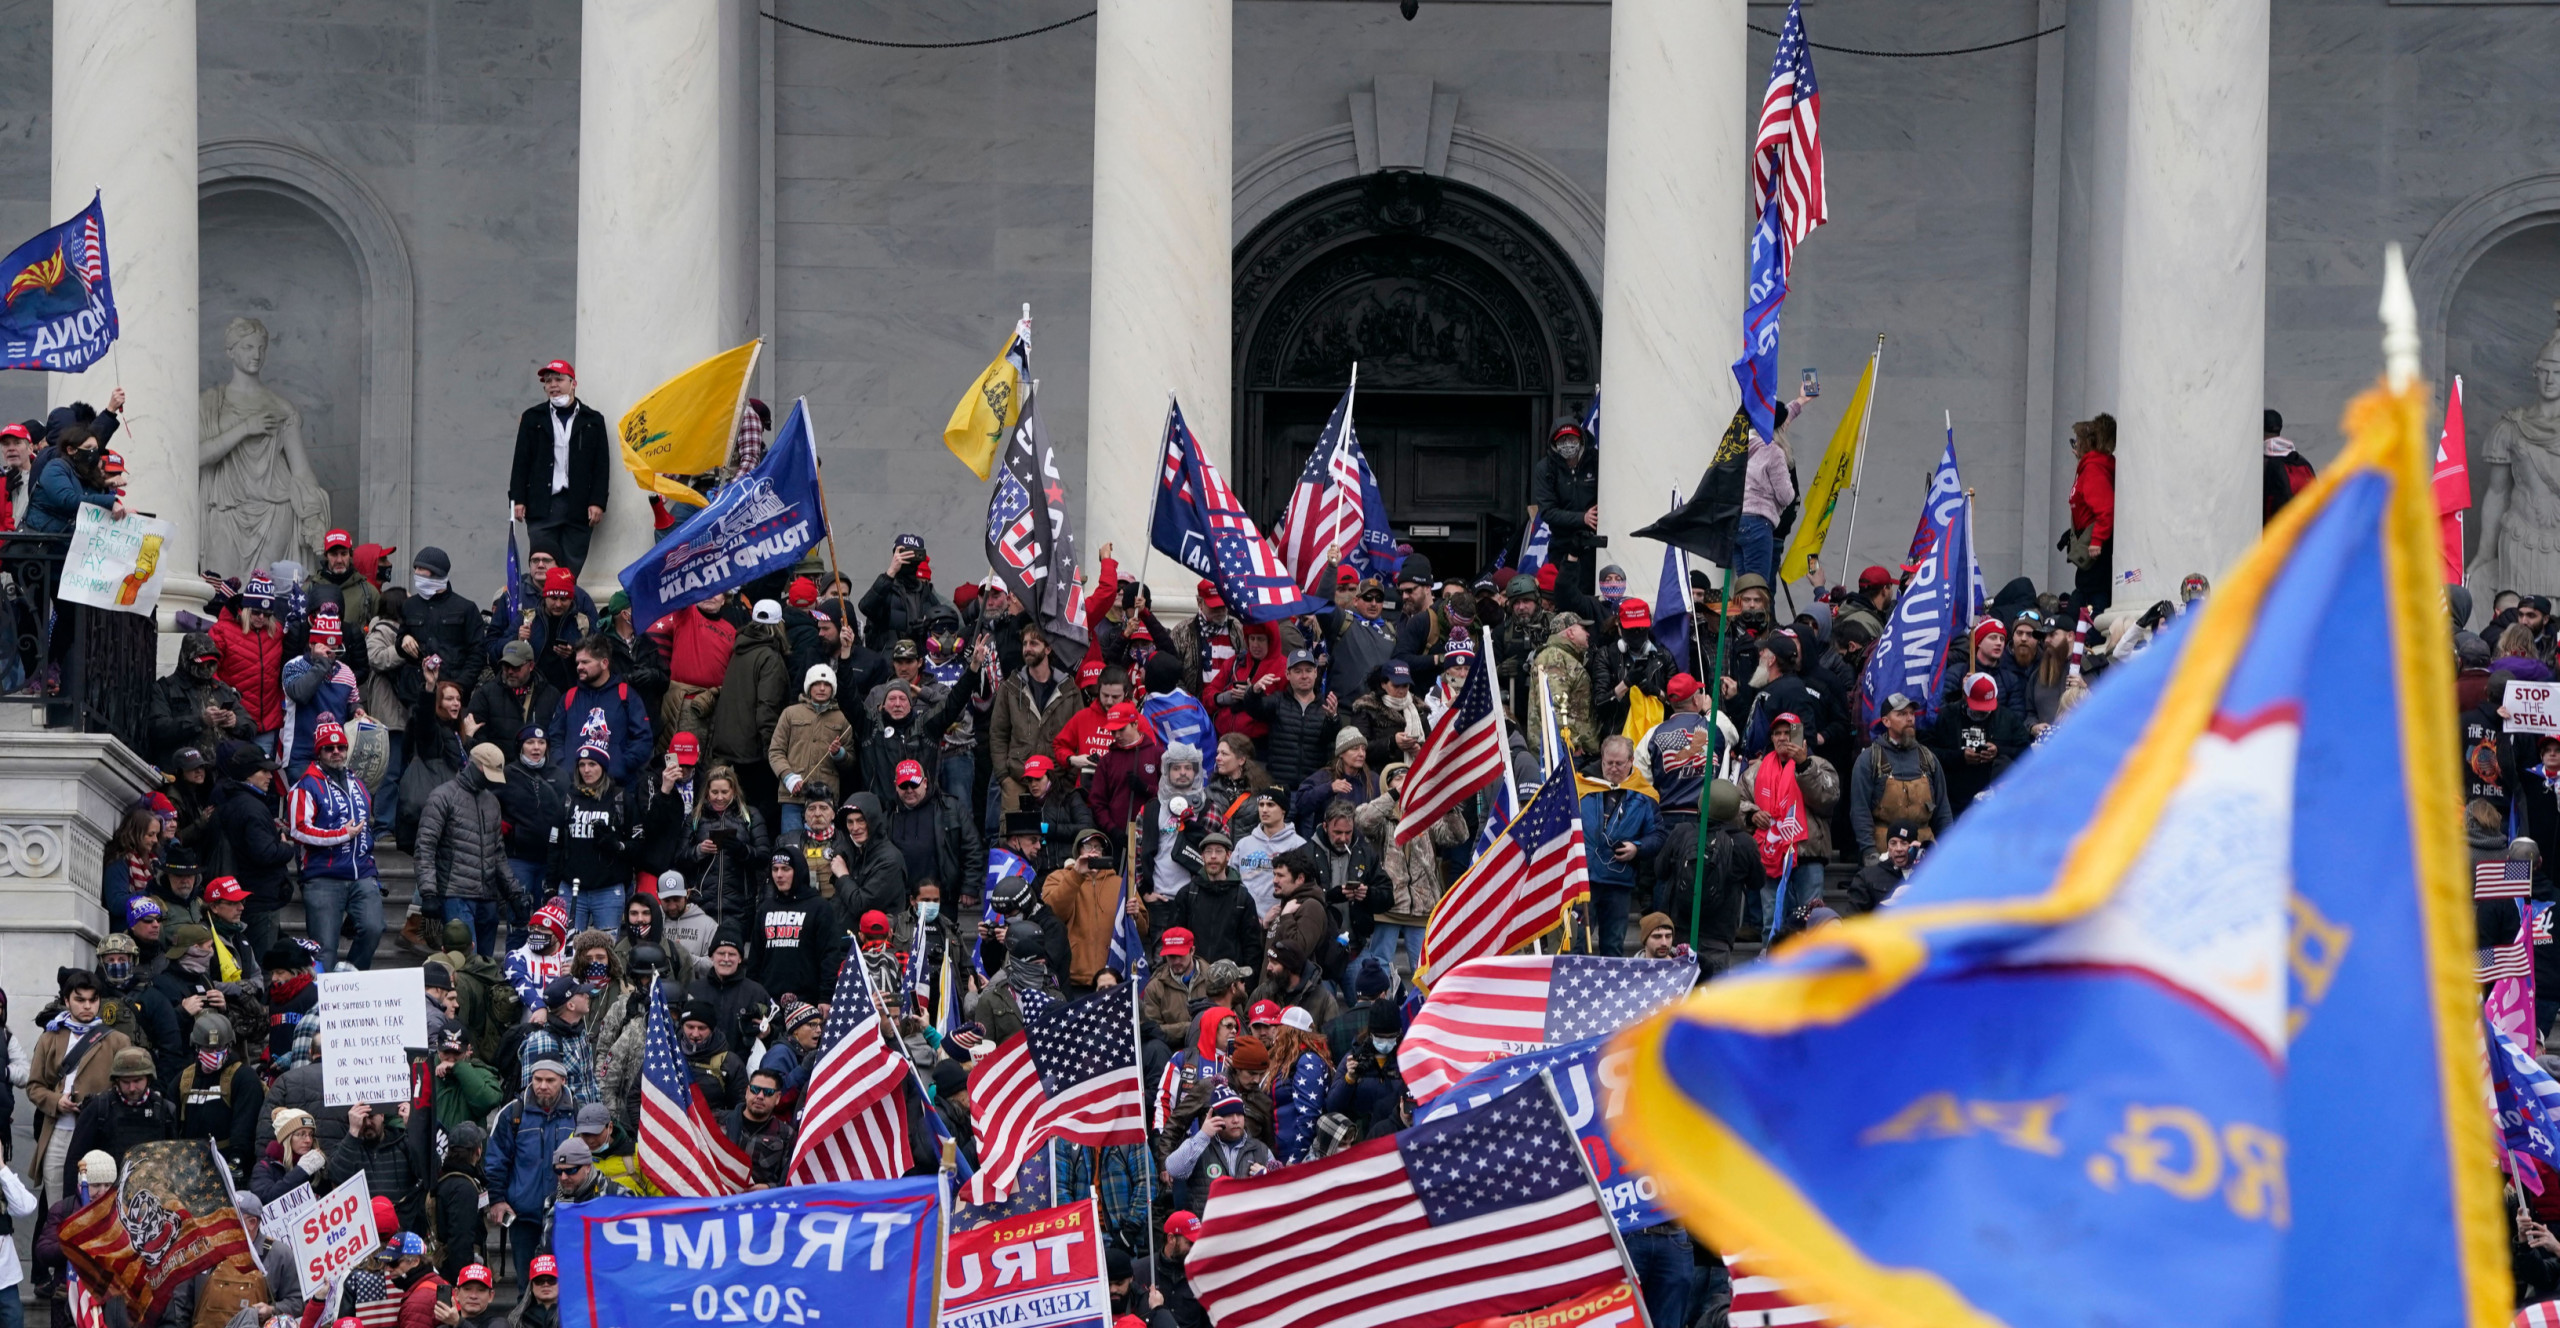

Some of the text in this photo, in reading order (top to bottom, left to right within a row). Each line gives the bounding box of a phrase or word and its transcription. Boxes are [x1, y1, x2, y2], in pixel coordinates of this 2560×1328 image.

[85, 507, 106, 523] YOU
[904, 536, 920, 547] USA
[1363, 529, 1388, 545] EEP
[2515, 688, 2550, 701] STOP
[2522, 701, 2544, 714] THE
[2513, 713, 2557, 728] STEAL
[1096, 727, 1113, 736] KE
[2468, 725, 2484, 739] THE
[1085, 736, 1117, 747] AMER
[1090, 747, 1110, 757] GRE
[2472, 783, 2480, 795] IS
[358, 808, 369, 858] AMRICA
[212, 889, 221, 898] 45
[765, 911, 806, 926] BIDEN
[664, 927, 698, 936] LACK RIFLE
[776, 926, 801, 938] NOT
[2533, 938, 2554, 947] EDOM
[320, 998, 403, 1012] ARE WE SUPPOSED TO HAVE
[326, 1015, 404, 1030] AN IRRATIONAL FEAR
[331, 1039, 340, 1049] OF
[343, 1038, 357, 1048] ALL
[337, 1058, 347, 1068] OR
[353, 1056, 374, 1066] ONLY
[380, 1055, 396, 1065] THE
[335, 1077, 349, 1086] FOR
[355, 1075, 380, 1085] WHICH
[325, 1087, 411, 1105] HAS A VACCINE TO SE
[280, 1185, 312, 1215] INJURY
[303, 1194, 358, 1245] Stop
[326, 1226, 347, 1246] the
[309, 1224, 369, 1282] Steal
